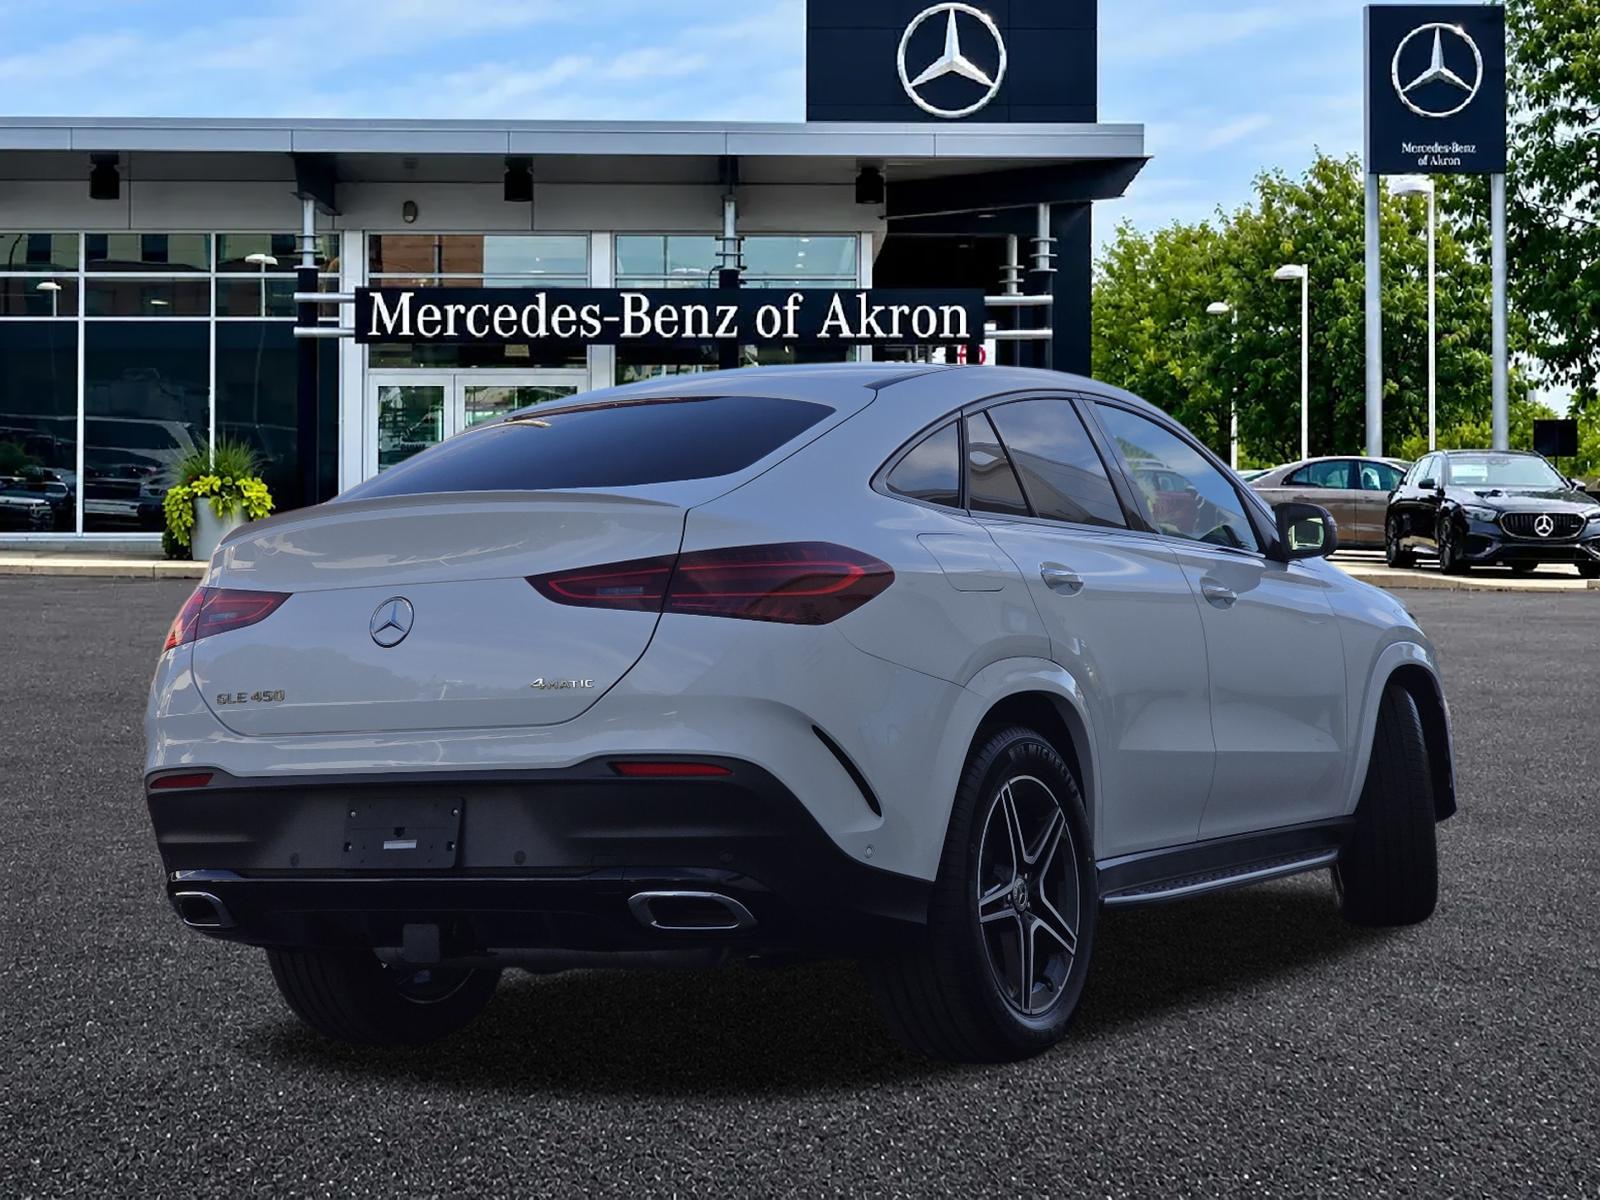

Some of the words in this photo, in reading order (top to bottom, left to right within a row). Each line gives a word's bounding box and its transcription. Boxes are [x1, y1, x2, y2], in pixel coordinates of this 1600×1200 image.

[1401, 141, 1477, 154] Mercedes-Benz
[1418, 154, 1428, 166] of
[1430, 154, 1461, 166] Akron
[367, 291, 738, 340] Mercedes-Benz
[755, 292, 805, 340] of
[817, 292, 970, 340] Akron
[529, 678, 595, 690] 4MATIC
[216, 692, 248, 705] GLE
[250, 689, 285, 703] 450
